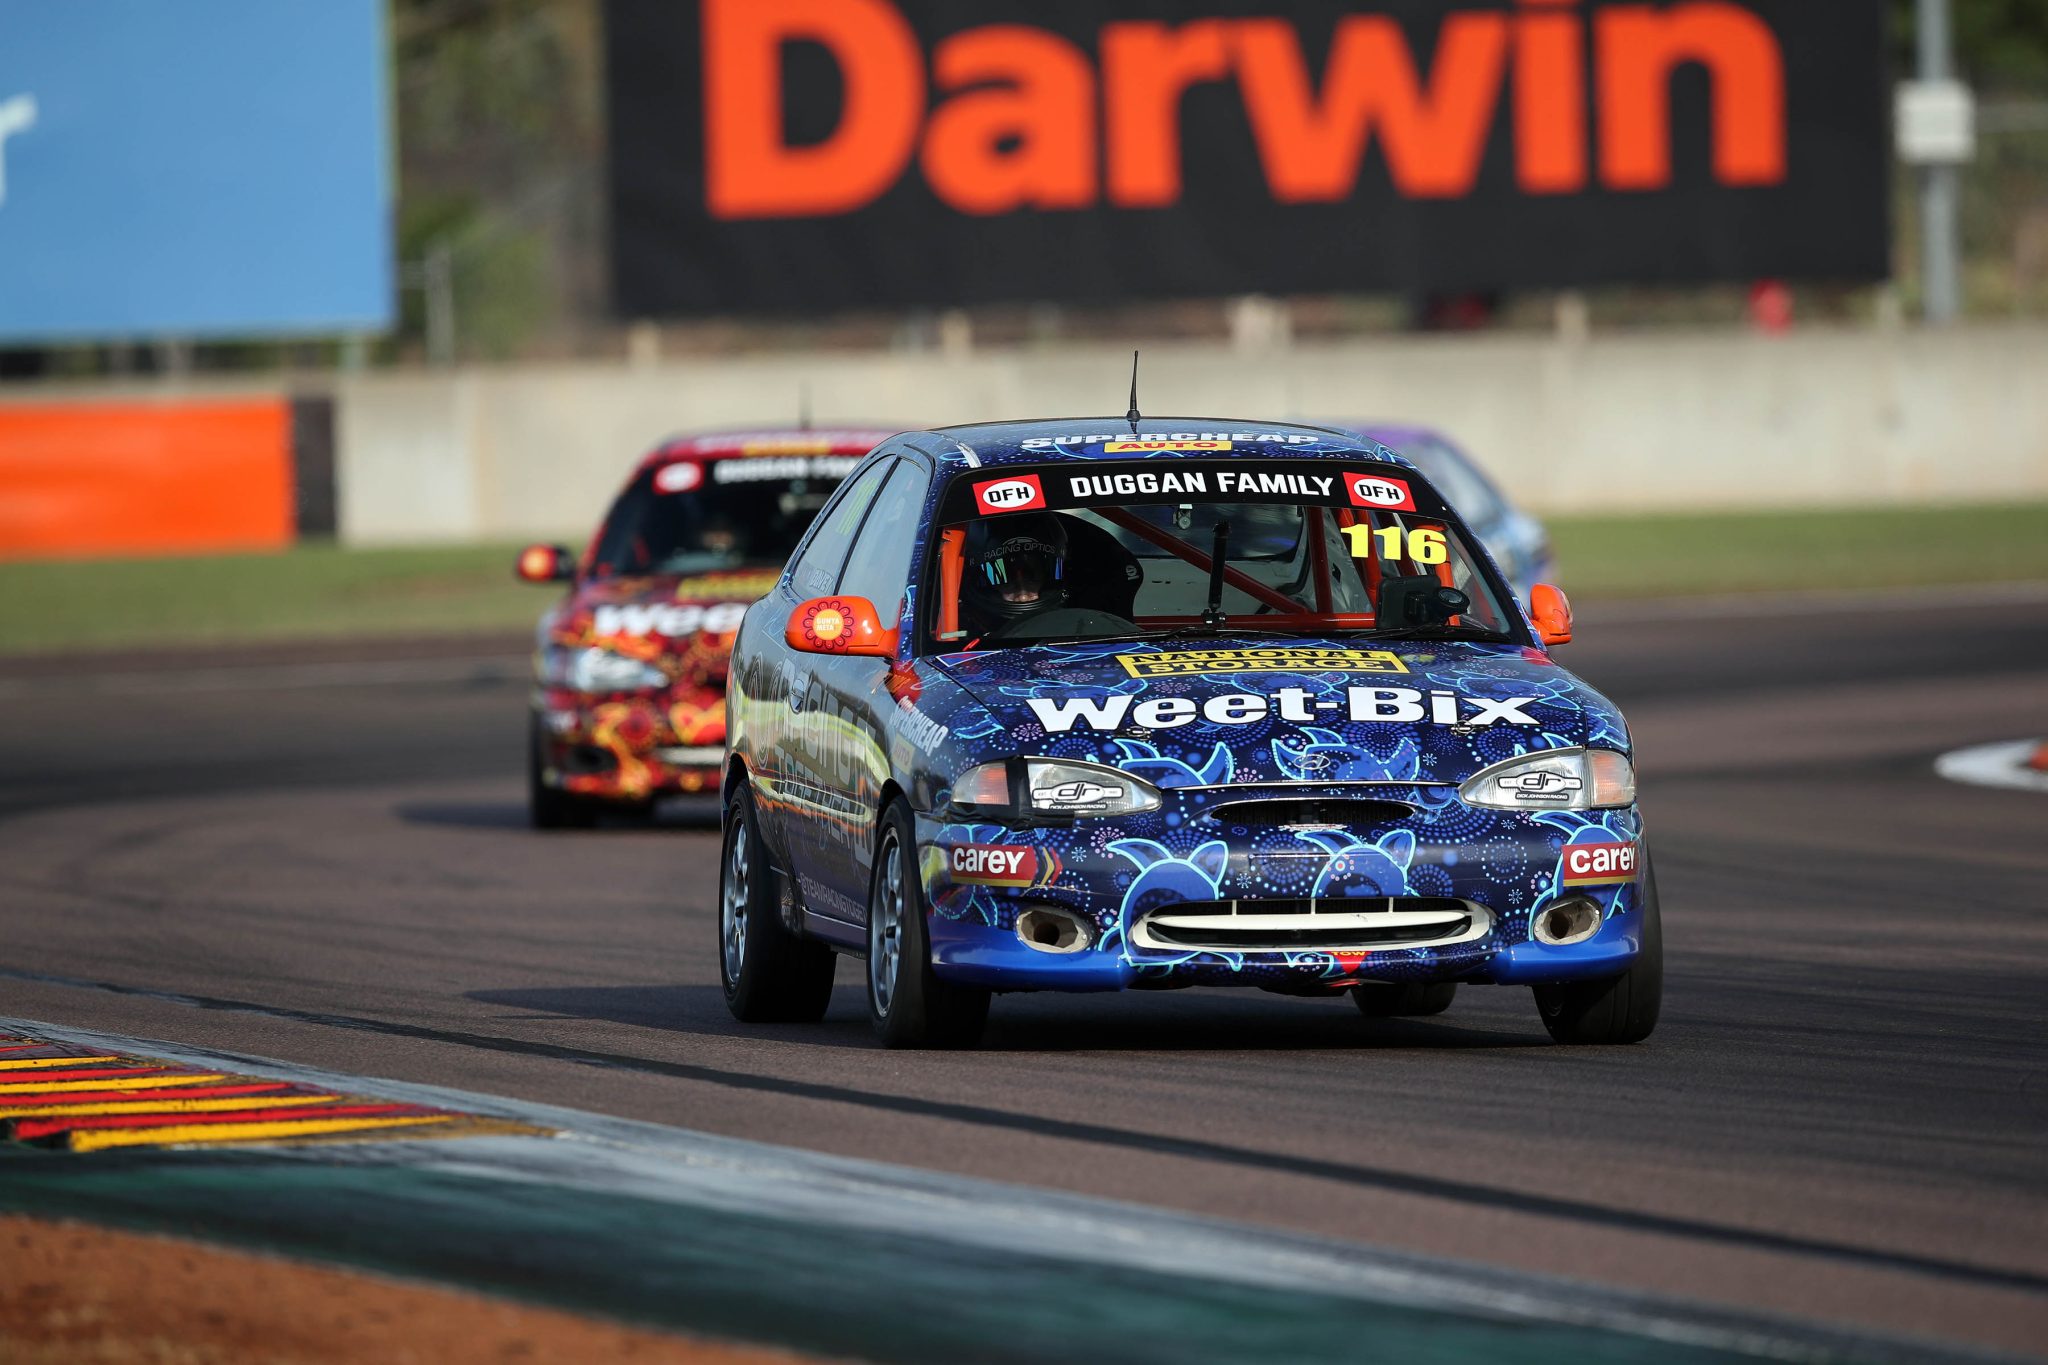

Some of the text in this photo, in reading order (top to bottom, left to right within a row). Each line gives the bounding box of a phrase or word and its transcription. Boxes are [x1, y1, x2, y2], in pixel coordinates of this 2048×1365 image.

[704, 0, 1786, 217] Darwin
[1019, 432, 1320, 449] SUPERCHEAP
[1117, 442, 1219, 450] AUTO
[1070, 472, 1334, 498] DUGGAN FAMILY
[1358, 484, 1401, 501] DFH
[988, 486, 1030, 503] DFH
[984, 543, 1056, 560] RACING OPTICS
[1340, 523, 1447, 565] 116
[1127, 650, 1382, 663] NATIONAL
[1148, 659, 1385, 674] STORAGE
[1025, 686, 1538, 733] Weet-Bix
